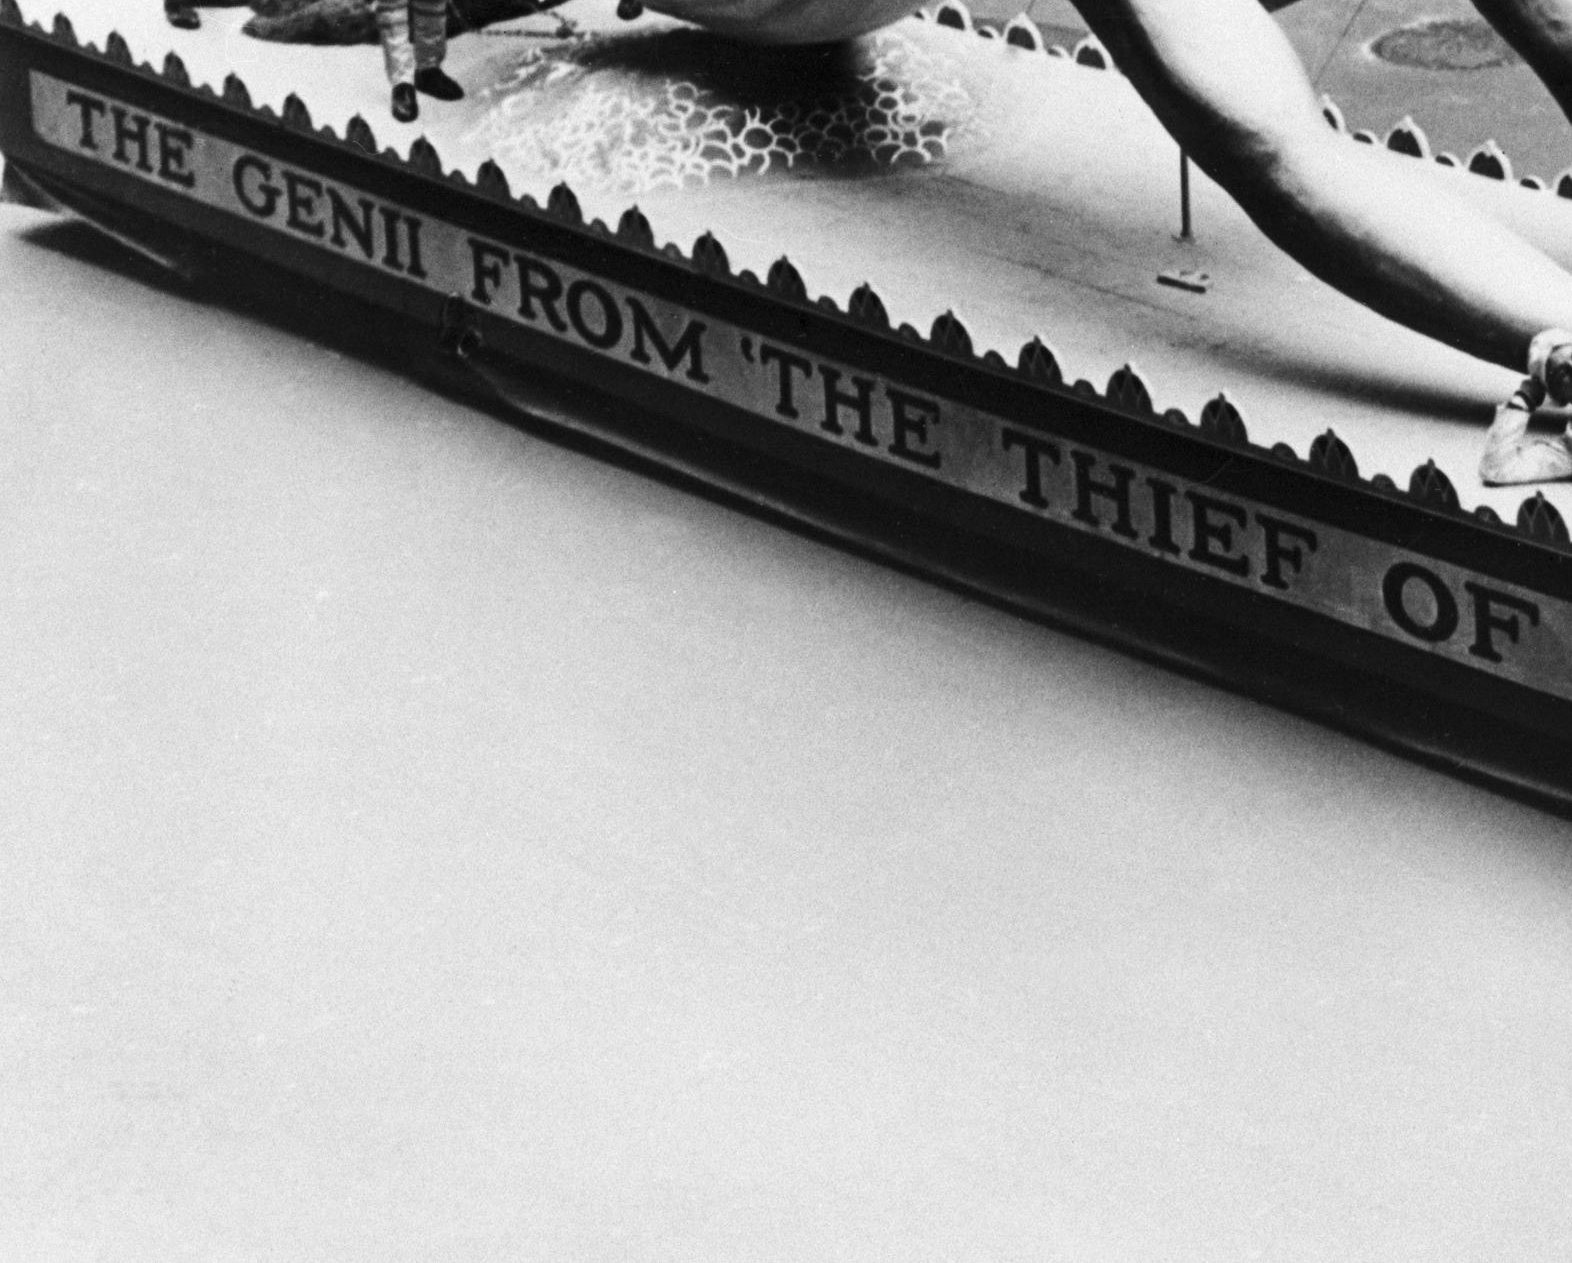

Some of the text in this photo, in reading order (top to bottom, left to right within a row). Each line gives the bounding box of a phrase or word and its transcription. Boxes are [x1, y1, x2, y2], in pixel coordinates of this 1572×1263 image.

[66, 90, 196, 188] THE
[232, 156, 428, 279] GENII
[466, 237, 708, 386] FROM
[1002, 426, 1318, 590] THIEF
[1382, 561, 1540, 662] OF
